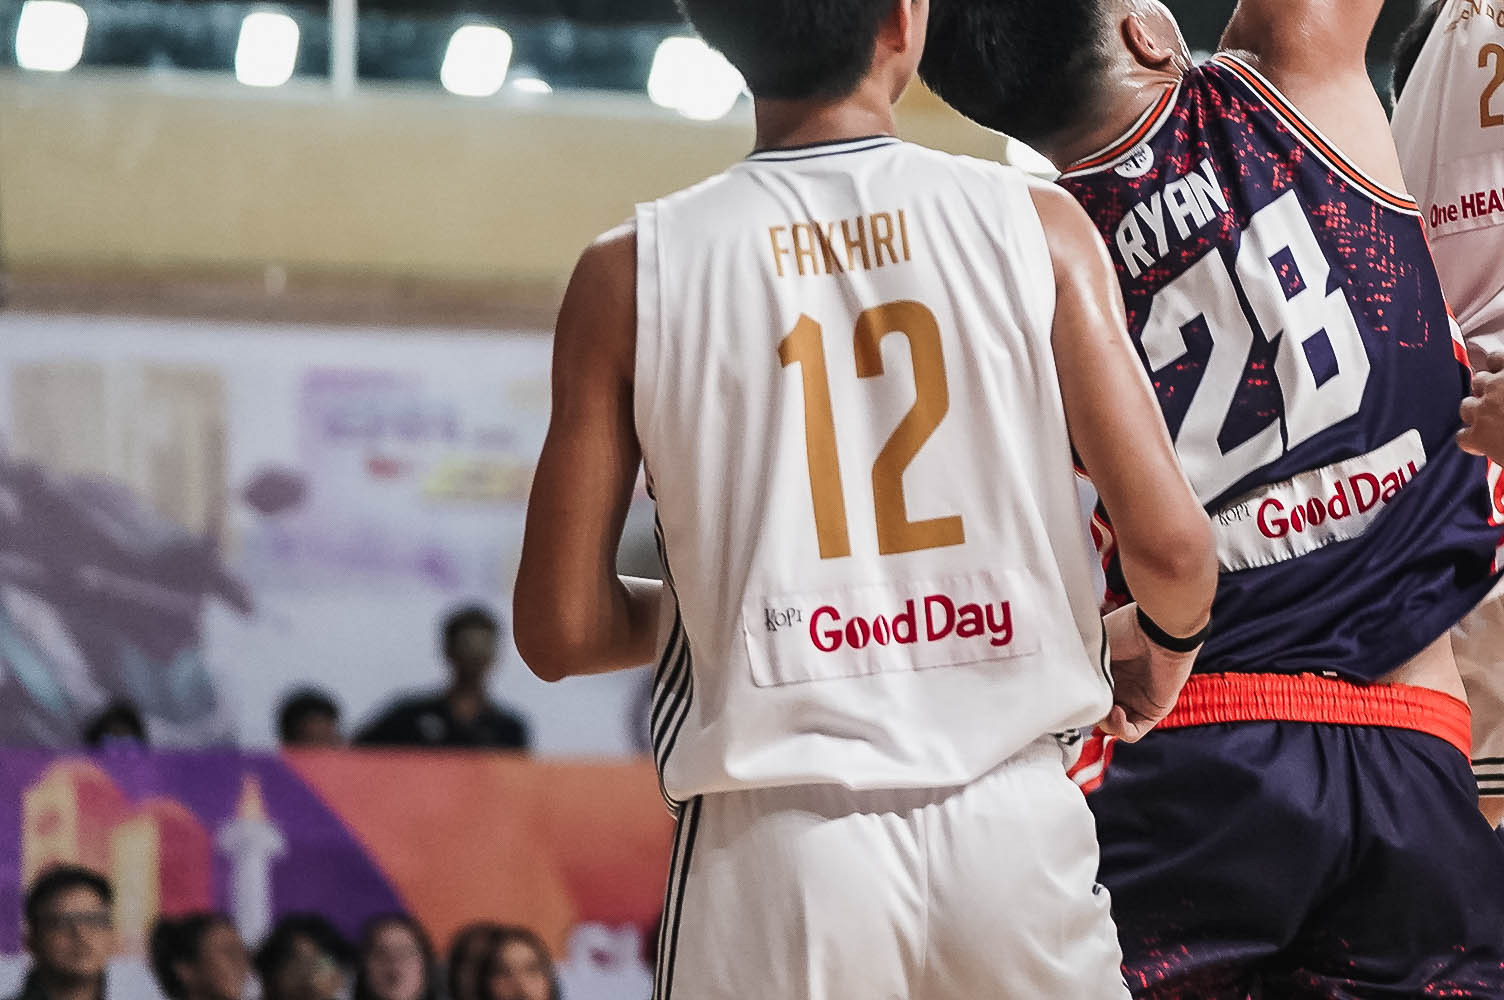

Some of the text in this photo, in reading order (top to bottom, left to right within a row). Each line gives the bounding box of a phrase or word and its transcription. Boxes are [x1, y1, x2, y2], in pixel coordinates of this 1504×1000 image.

[769, 210, 911, 277] FAKHRI
[1115, 159, 1229, 278] RYAN
[1430, 204, 1457, 228] One
[1140, 188, 1371, 507] 28
[778, 300, 967, 561] 12
